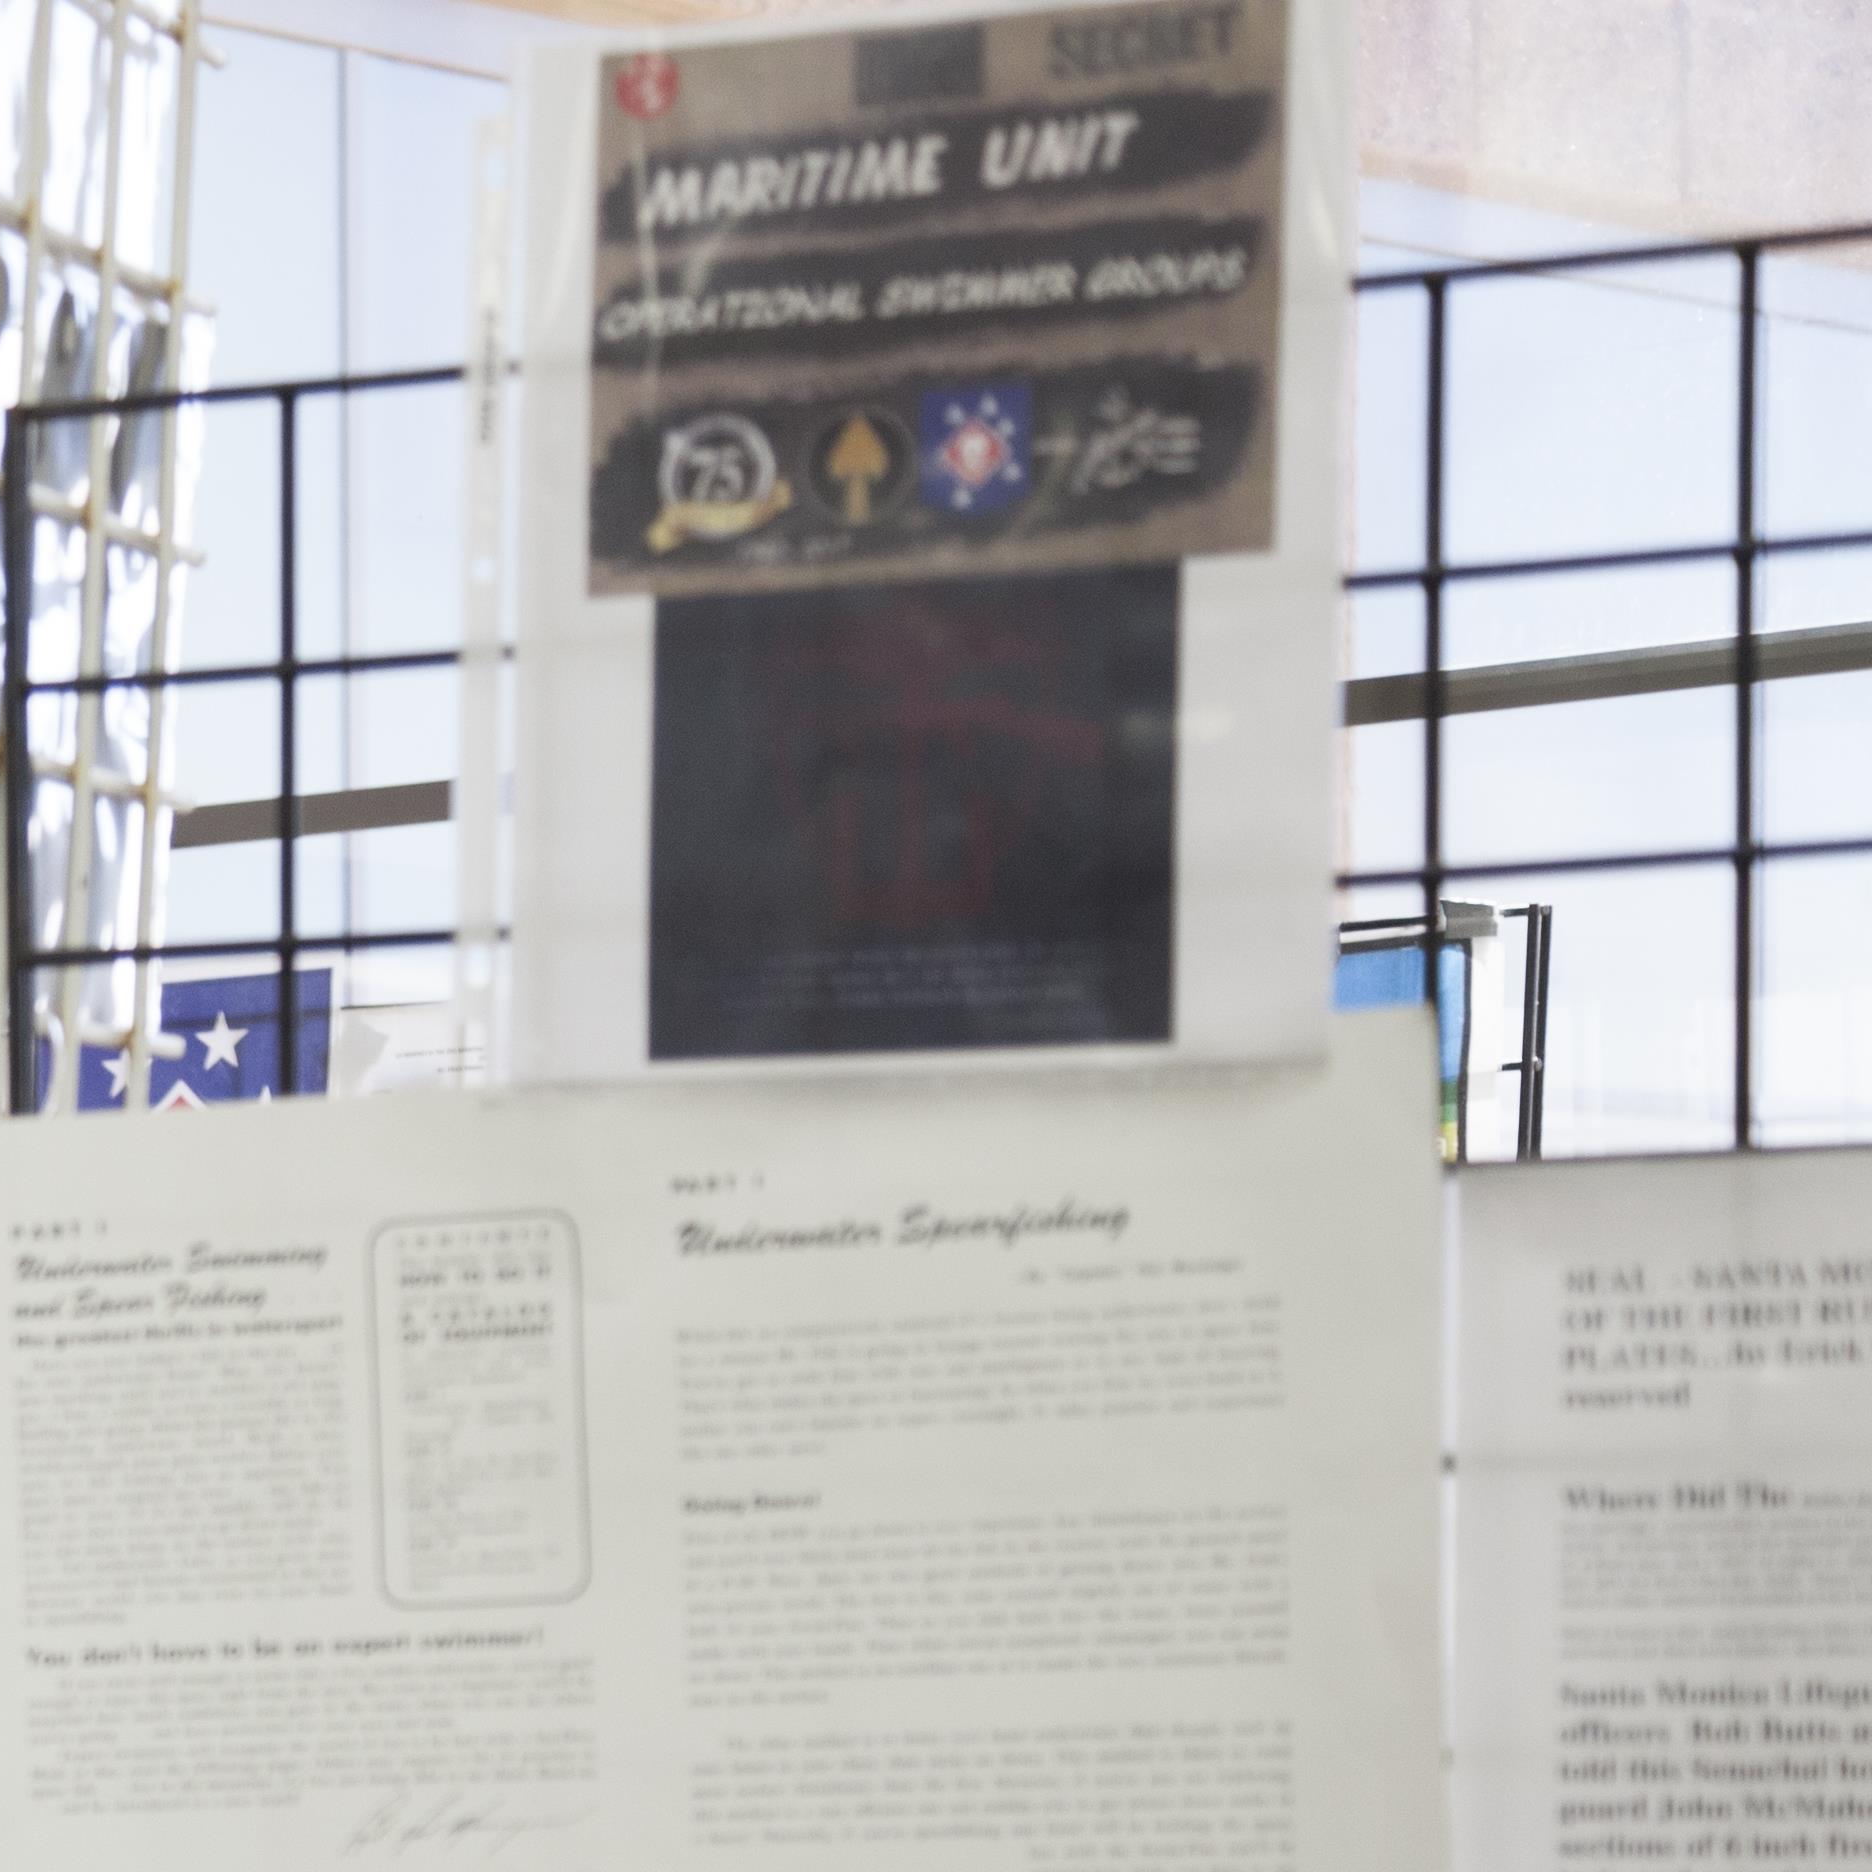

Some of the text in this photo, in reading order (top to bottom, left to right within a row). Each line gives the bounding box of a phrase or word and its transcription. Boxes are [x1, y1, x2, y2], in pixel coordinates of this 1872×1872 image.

[1051, 3, 1241, 77] SECRET
[641, 112, 1139, 228] MARITIME UNIT
[601, 247, 1248, 338] OPERATIONAL SWIMMER GROUPS
